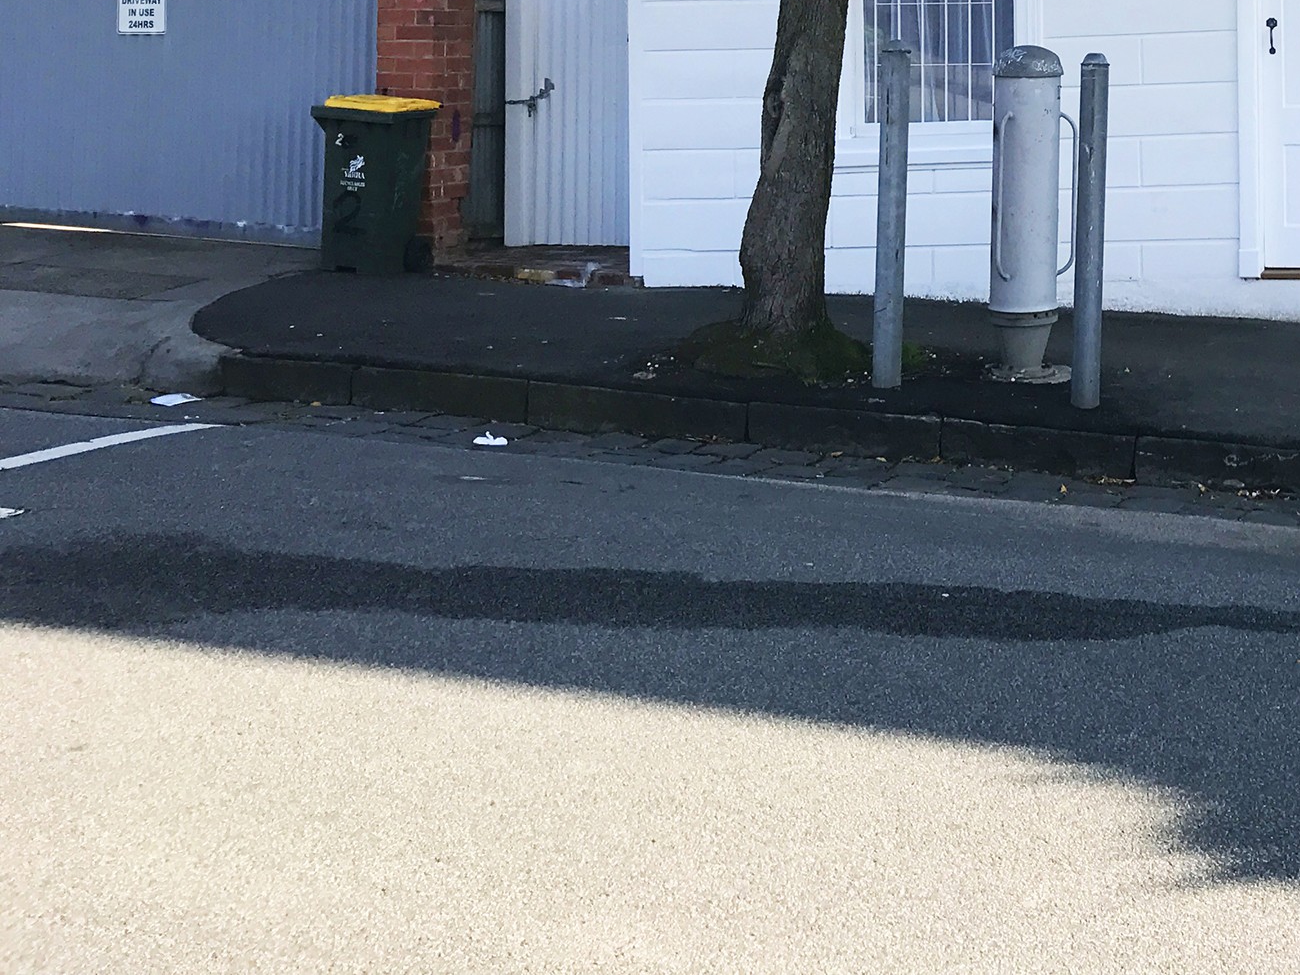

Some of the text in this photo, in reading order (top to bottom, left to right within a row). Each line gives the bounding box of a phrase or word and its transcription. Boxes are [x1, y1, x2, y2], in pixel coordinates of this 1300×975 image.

[128, 8, 155, 17] IN USE
[128, 20, 154, 29] 24HRS
[335, 133, 344, 146] 2
